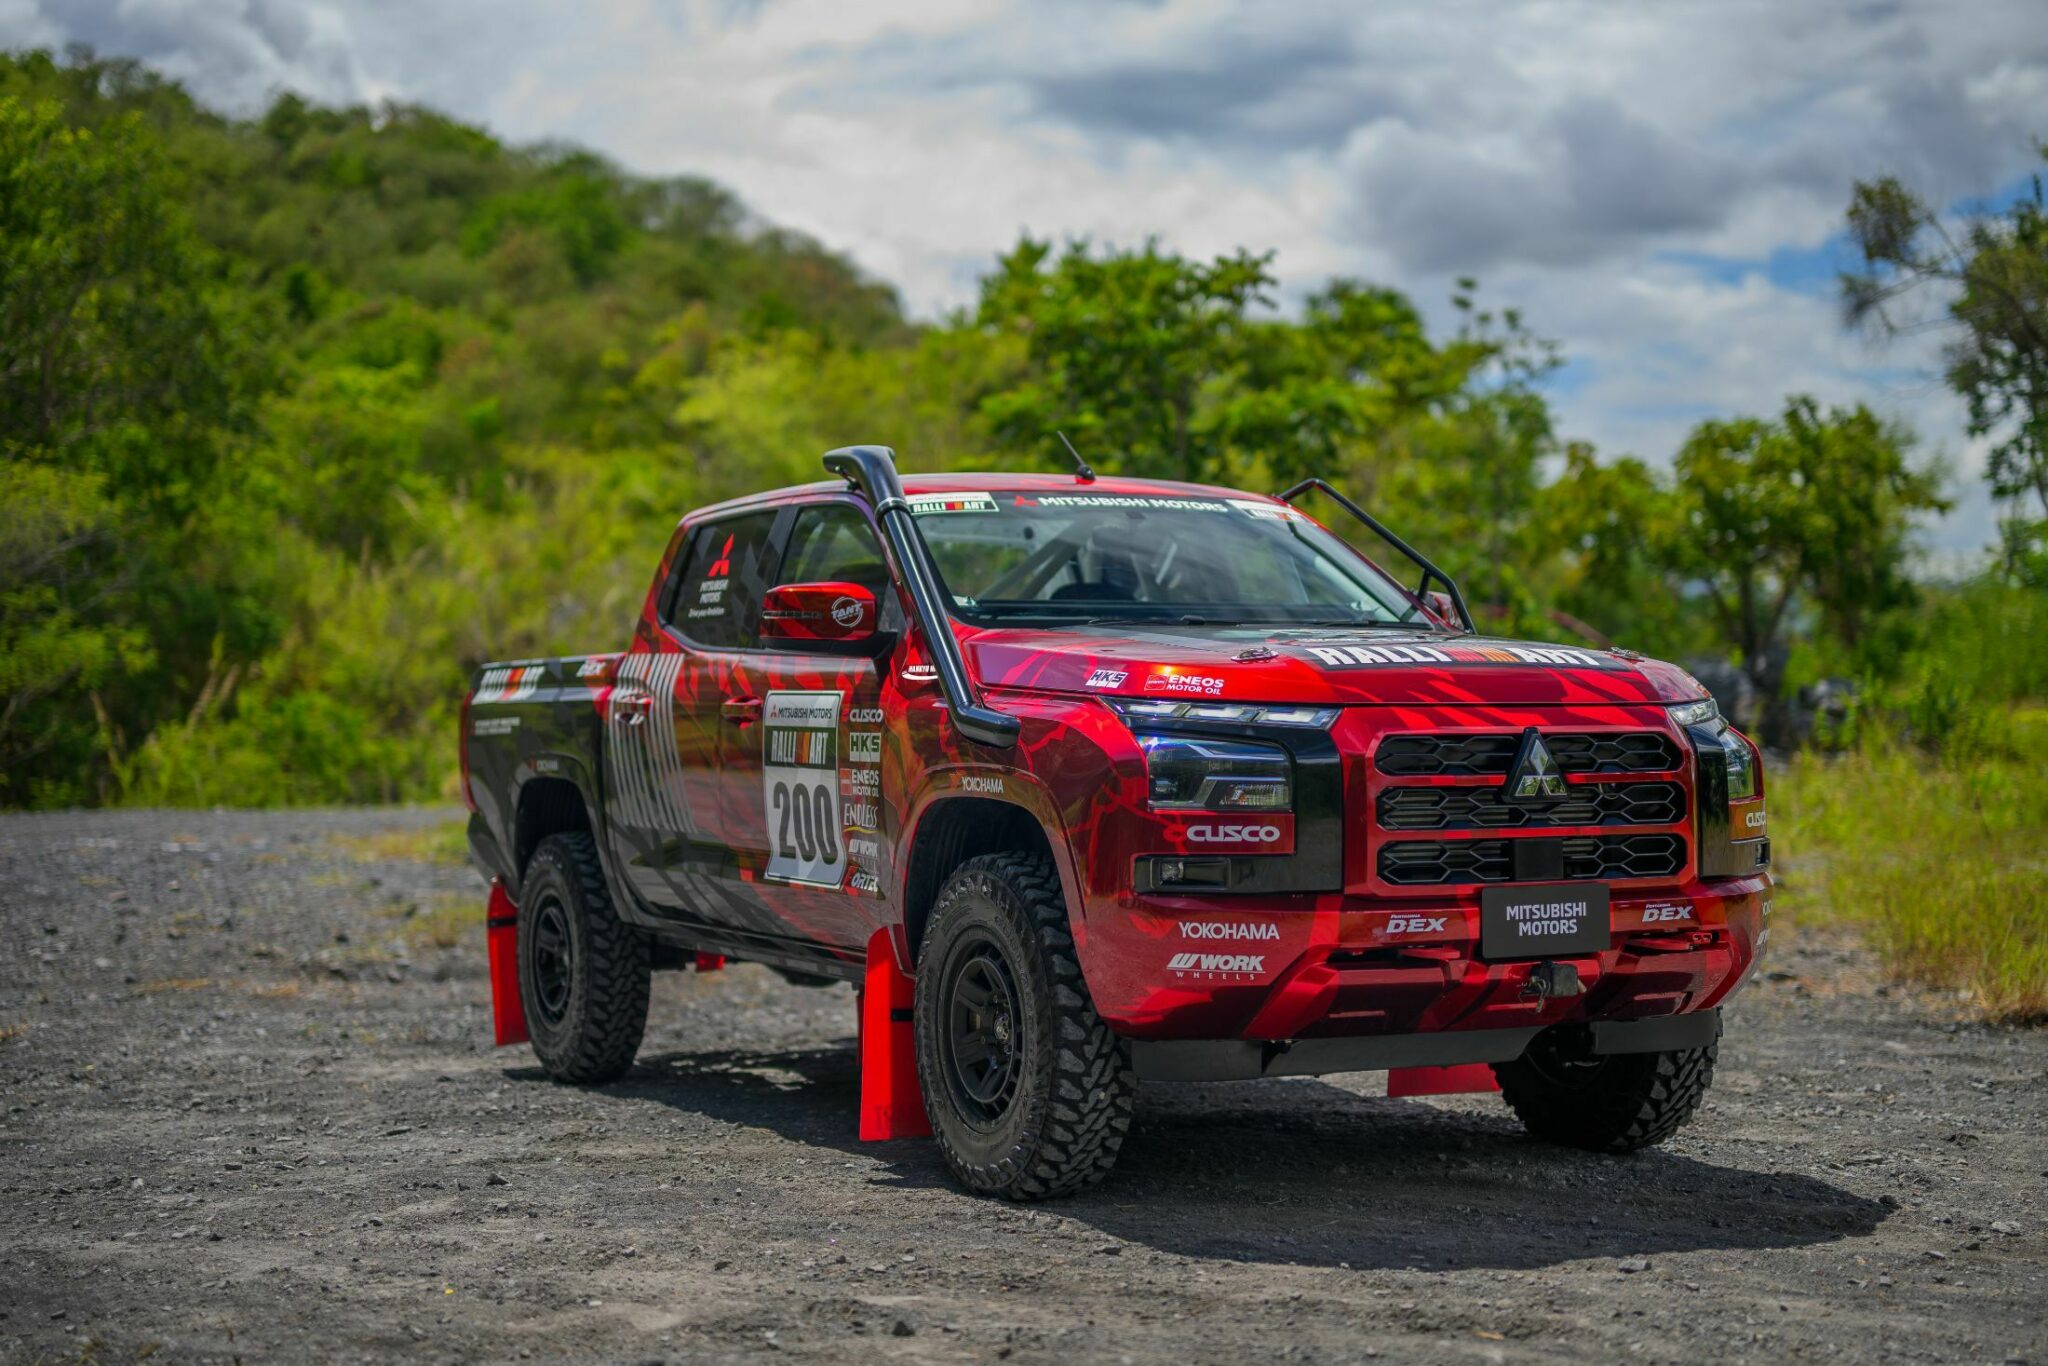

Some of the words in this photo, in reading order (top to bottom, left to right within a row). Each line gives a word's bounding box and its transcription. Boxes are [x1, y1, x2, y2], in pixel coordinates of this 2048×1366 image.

[1037, 496, 1150, 507] MITSUBISHI
[1150, 499, 1229, 512] MOTORS
[1089, 670, 1126, 684] HKS
[1168, 675, 1225, 688] ENEOS
[1166, 684, 1202, 693] MOTOR
[778, 707, 809, 718] MITSUBISHI
[809, 708, 833, 719] MOTORS
[850, 708, 883, 723] CUSCO
[850, 734, 881, 753] HKS
[851, 768, 880, 786] ENEOS
[961, 776, 1004, 794] YOKOHAMA
[773, 781, 839, 865] 200
[844, 803, 879, 829] ENDLESS
[1186, 825, 1281, 842] CUSCO
[1506, 902, 1587, 921] MITSUBISHI
[1641, 905, 1693, 922] DEX
[1178, 921, 1280, 940] YOKOHAMA
[1386, 917, 1448, 933] DEX
[1518, 920, 1578, 937] MOTORS
